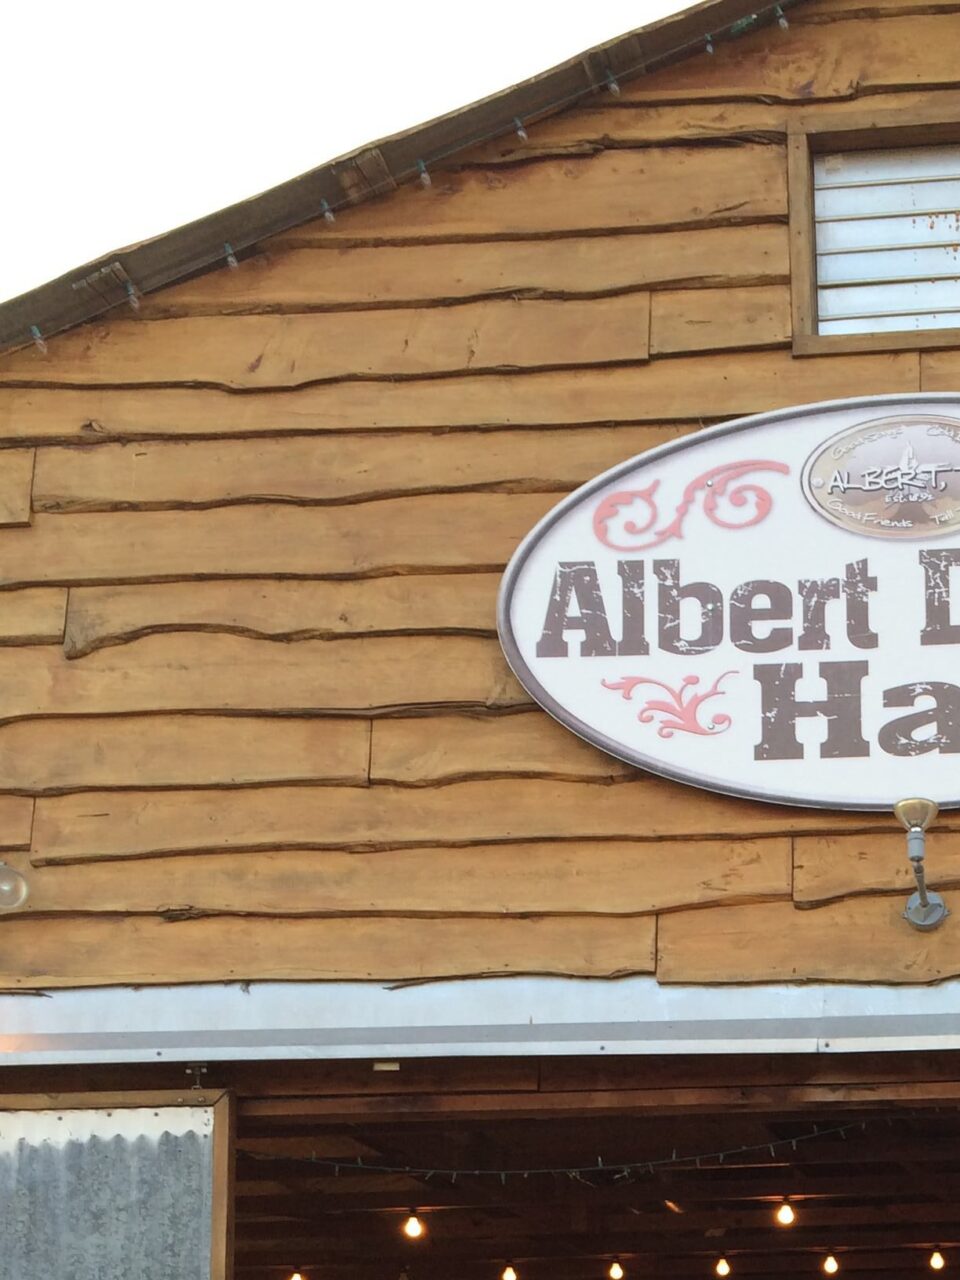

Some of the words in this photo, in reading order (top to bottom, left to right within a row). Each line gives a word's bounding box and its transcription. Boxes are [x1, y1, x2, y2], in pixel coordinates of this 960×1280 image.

[926, 424, 954, 441] Cold
[828, 462, 951, 494] ALBERT,
[826, 497, 862, 521] Good
[861, 511, 914, 529] Friends
[930, 507, 957, 526] Tall
[535, 558, 879, 659] Albert
